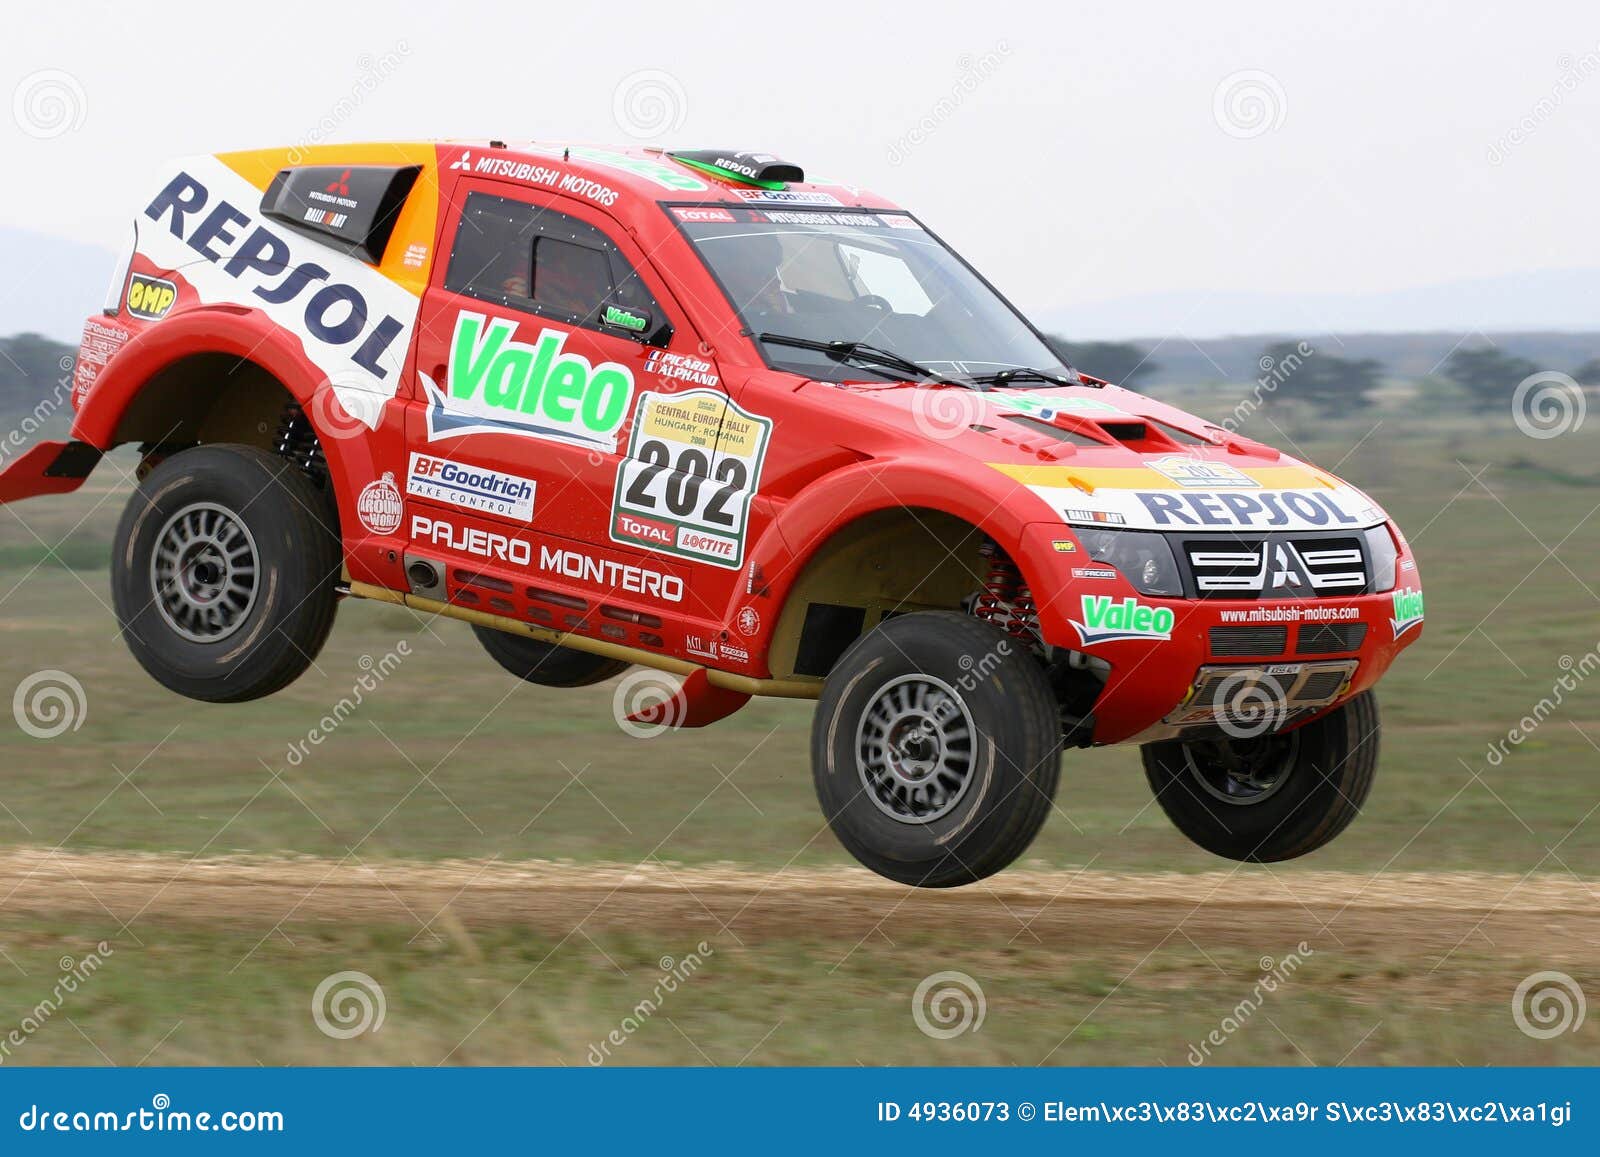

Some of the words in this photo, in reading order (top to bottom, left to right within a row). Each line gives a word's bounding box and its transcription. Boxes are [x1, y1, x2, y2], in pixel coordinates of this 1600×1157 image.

[475, 156, 559, 184] MITSUBISHI
[559, 175, 619, 206] MOTORS
[714, 158, 757, 178] REPSOL
[144, 171, 404, 380] REPSOL
[129, 281, 174, 314] OMP
[607, 307, 646, 329] Valeo
[450, 312, 632, 433] Valeo
[657, 364, 719, 387] ALPHAND
[662, 352, 711, 373] PICARD
[654, 417, 697, 434] HUNGARY
[703, 427, 745, 444] ROMANIA
[655, 404, 691, 421] CENTRAL
[726, 420, 751, 434] RALLY
[413, 456, 532, 500] BFGoodrich
[626, 440, 747, 526] 202
[409, 482, 441, 497] TAKE
[450, 492, 513, 515] CONTROL
[1135, 491, 1358, 526] REPSOL
[620, 517, 671, 542] TOTAL
[682, 533, 733, 555] LOCTITE
[411, 515, 531, 565] PAJERO
[540, 544, 684, 602] MONTERO
[1082, 595, 1174, 634] Valeo
[1220, 606, 1360, 622] www.mitsubishi-motors.com
